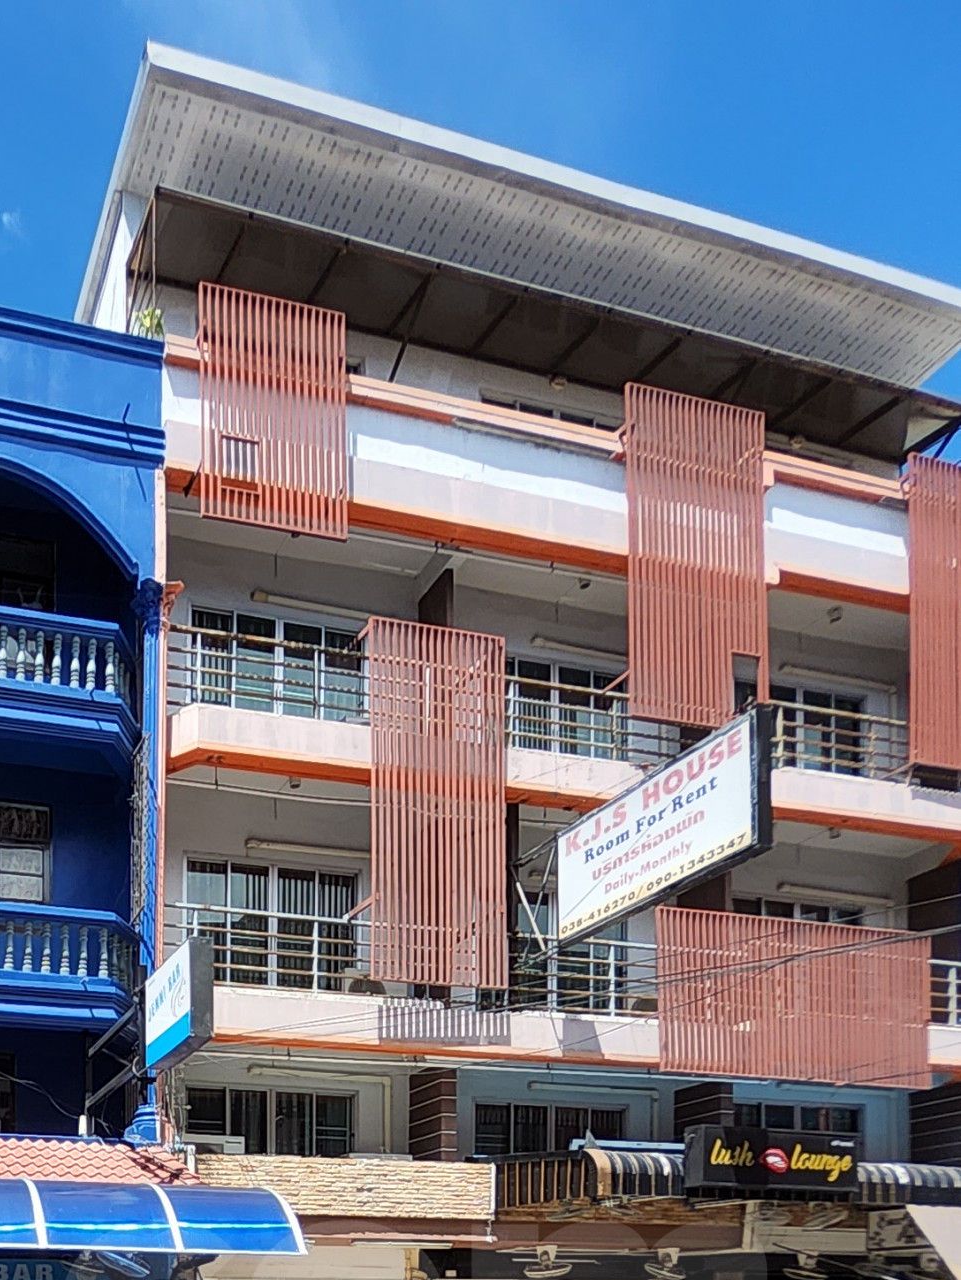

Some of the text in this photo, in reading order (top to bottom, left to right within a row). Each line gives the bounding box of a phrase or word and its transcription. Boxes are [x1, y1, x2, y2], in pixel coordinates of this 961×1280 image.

[564, 729, 743, 857] K.J.S HOUSE
[584, 776, 718, 864] Room For Rent
[790, 1143, 853, 1182] lounge
